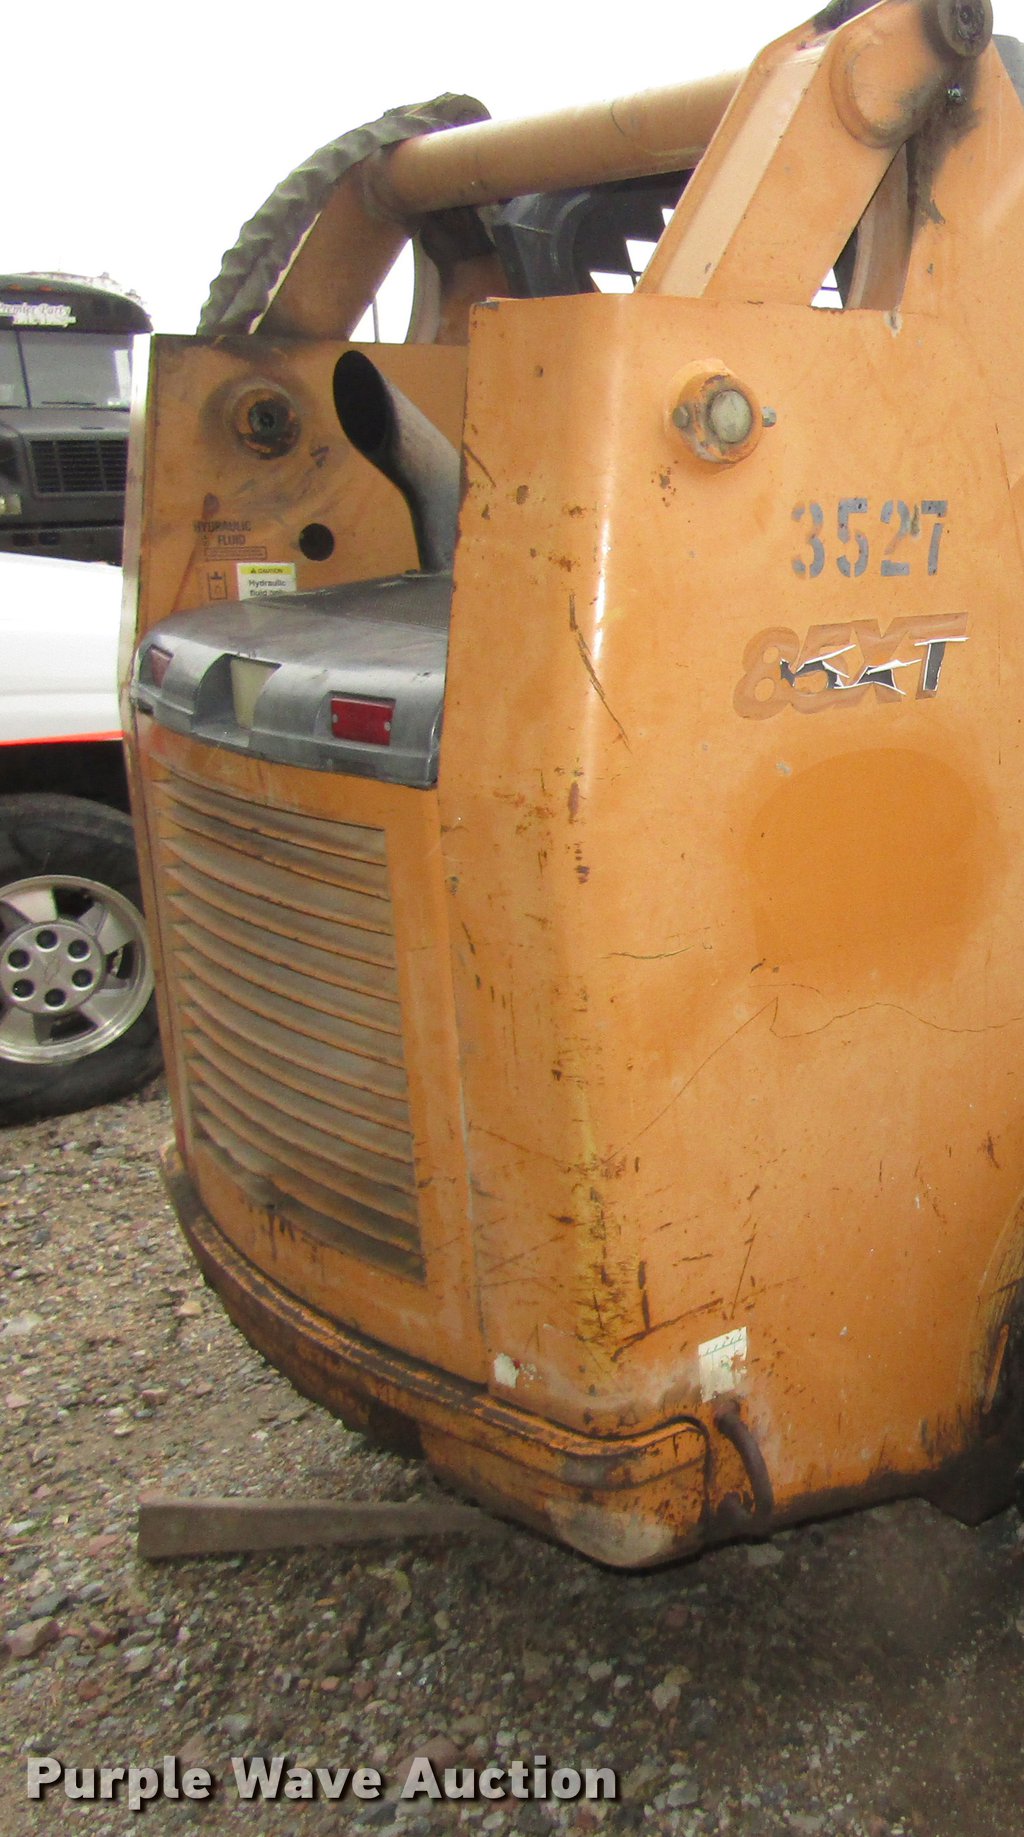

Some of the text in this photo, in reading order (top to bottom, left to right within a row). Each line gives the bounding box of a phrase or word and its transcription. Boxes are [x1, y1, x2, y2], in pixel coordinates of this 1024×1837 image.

[194, 520, 251, 532] HYDRAULIC
[218, 534, 247, 545] FLUID
[791, 498, 949, 578] 3527
[248, 580, 287, 588] Hydraulic
